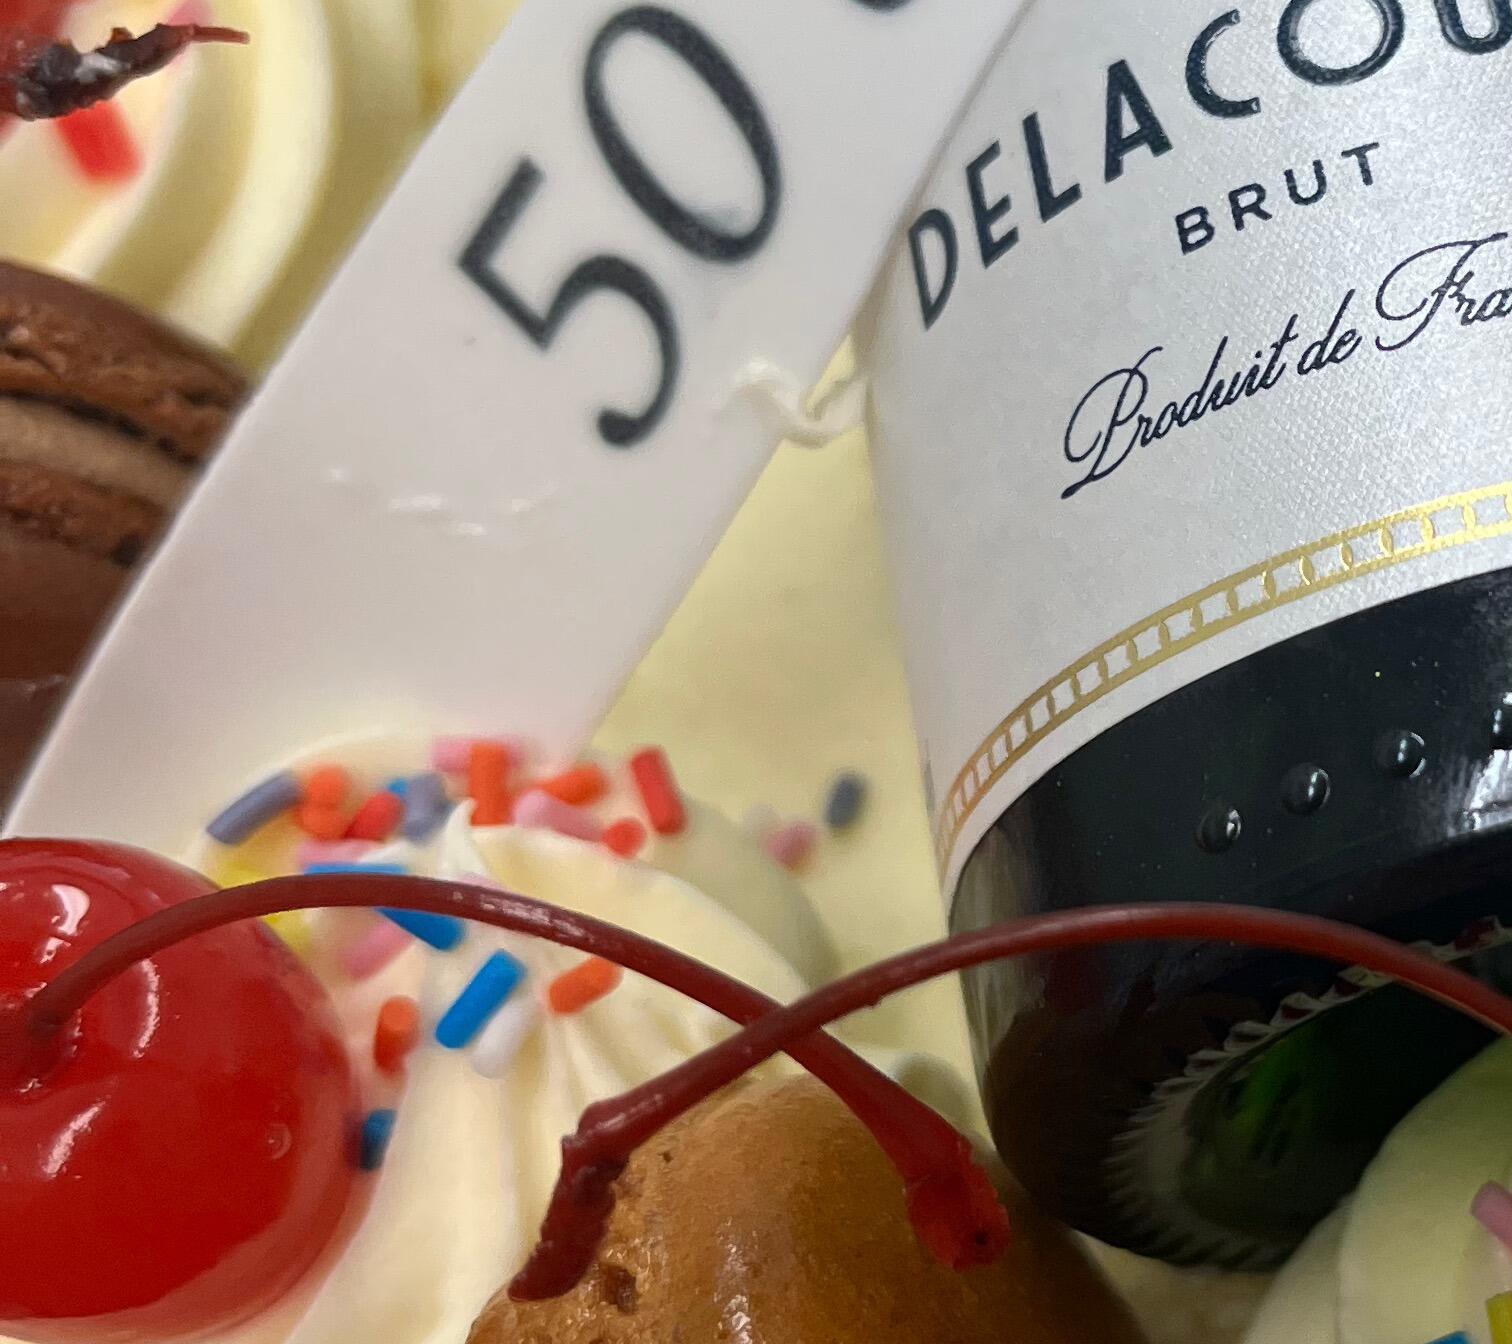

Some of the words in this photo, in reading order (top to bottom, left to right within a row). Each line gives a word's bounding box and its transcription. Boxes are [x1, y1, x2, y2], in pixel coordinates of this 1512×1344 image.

[458, 3, 784, 450] 50
[1174, 141, 1381, 256] BRUT
[1062, 315, 1298, 500] Produit
[1299, 289, 1362, 373] de
